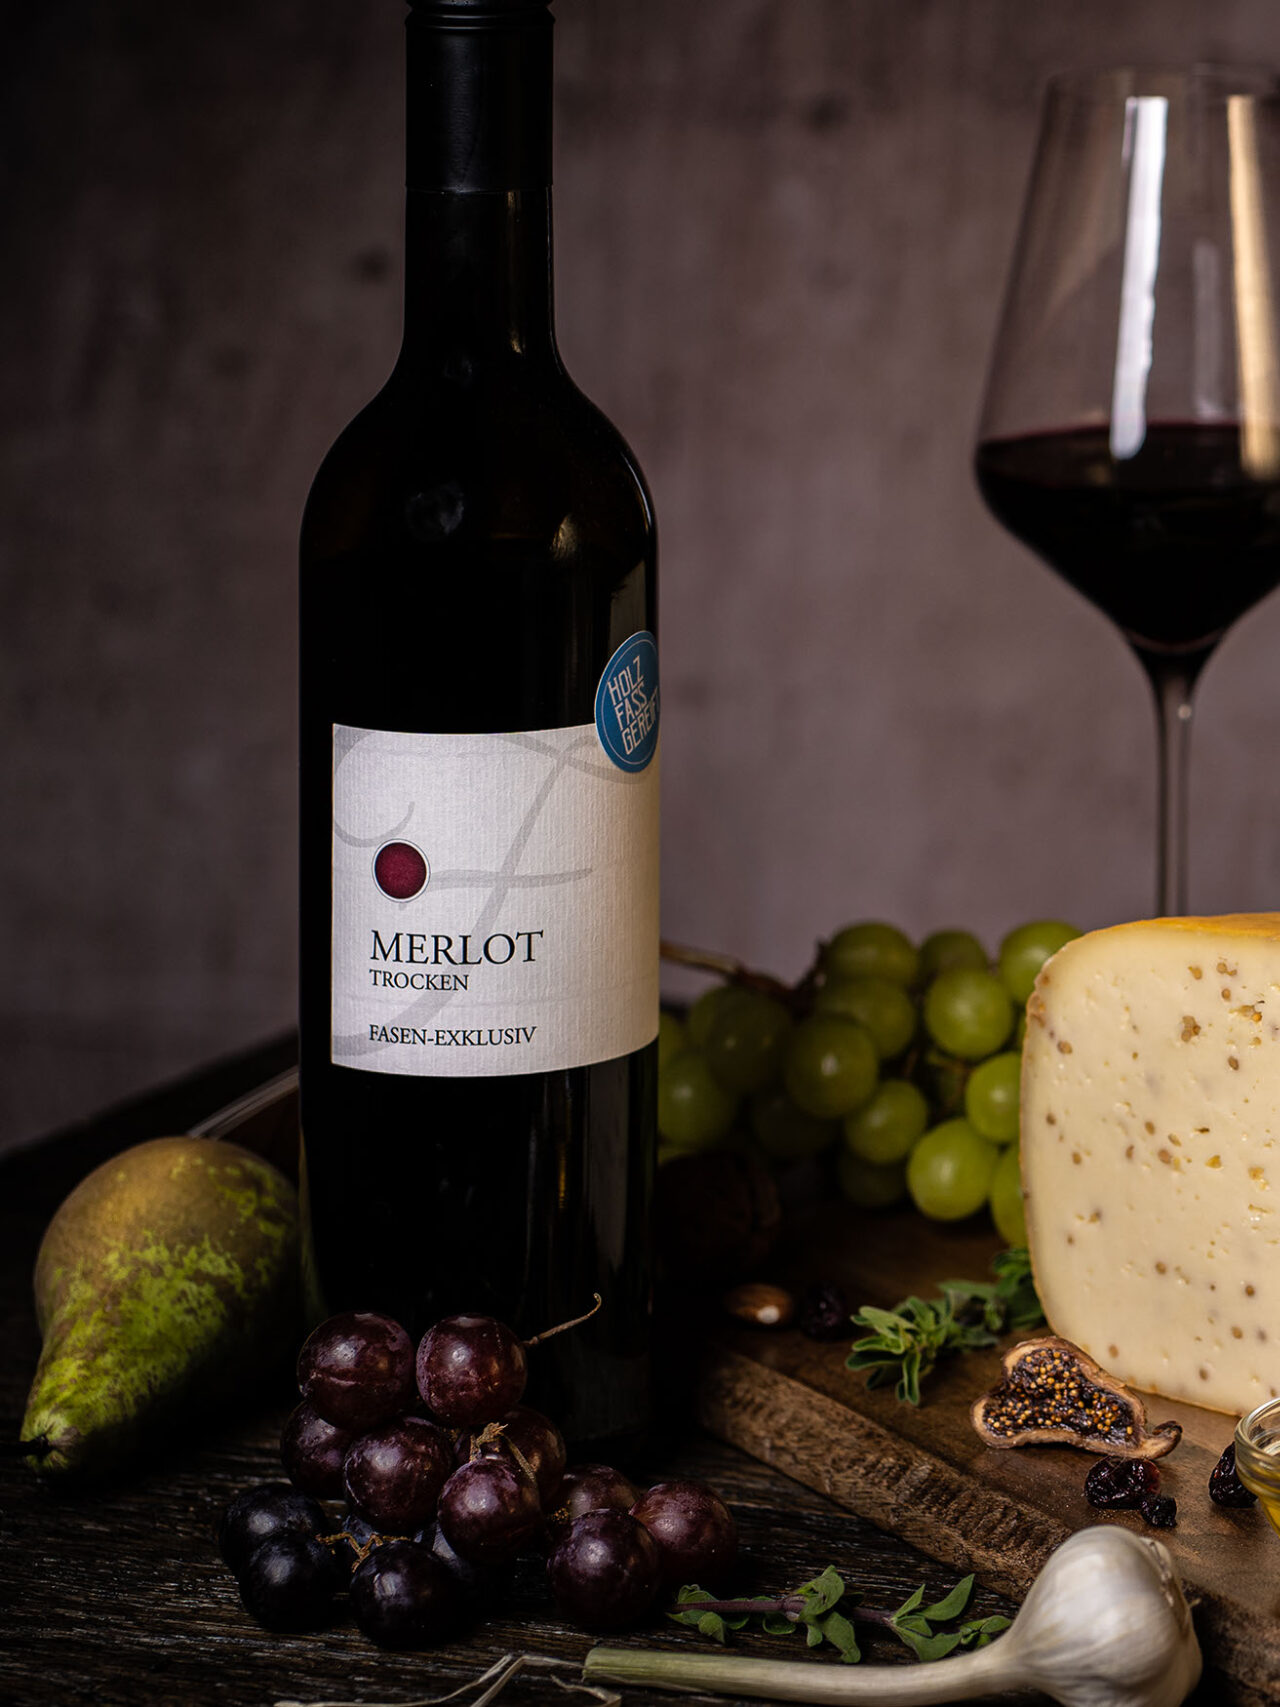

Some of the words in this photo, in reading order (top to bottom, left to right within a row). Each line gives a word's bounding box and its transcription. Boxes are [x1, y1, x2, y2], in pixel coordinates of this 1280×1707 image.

[607, 655, 644, 705] HOLZ
[614, 681, 647, 731] FASS
[371, 930, 544, 965] MERLOT
[369, 968, 469, 991] TROCKEN
[369, 1024, 537, 1046] FASEN-EXKLUSIV
